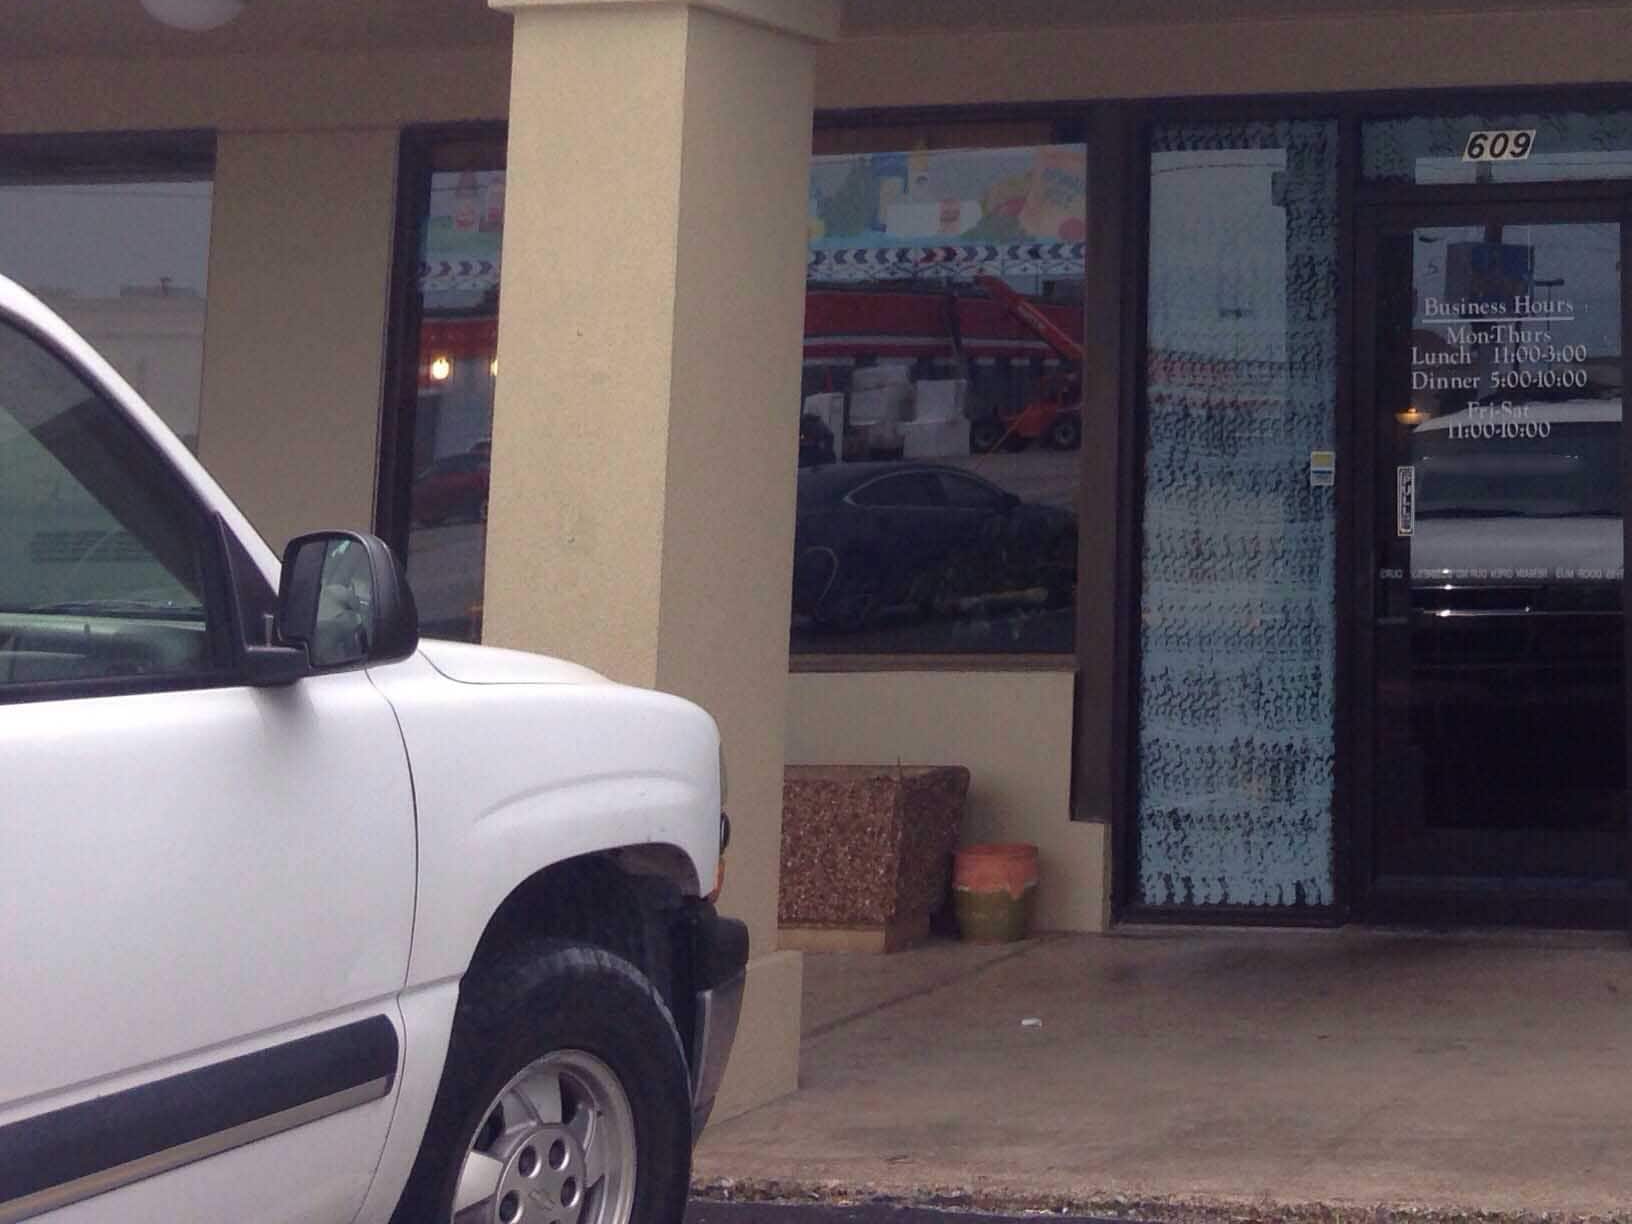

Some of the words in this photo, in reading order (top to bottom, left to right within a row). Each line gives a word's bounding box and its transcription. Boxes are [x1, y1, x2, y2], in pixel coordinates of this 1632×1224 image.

[1467, 132, 1531, 159] 609
[1424, 297, 1507, 317] Business
[1514, 295, 1574, 314] Hours
[1447, 325, 1552, 345] Mon-Thurs
[1411, 345, 1472, 366] Lunch
[1493, 344, 1587, 364] 11:00-3:00
[1411, 371, 1481, 391] Dinner
[1490, 369, 1588, 389] 5:00-10:00
[1467, 401, 1529, 420] Fri-Sat
[1447, 421, 1551, 440] 11:00-10:00
